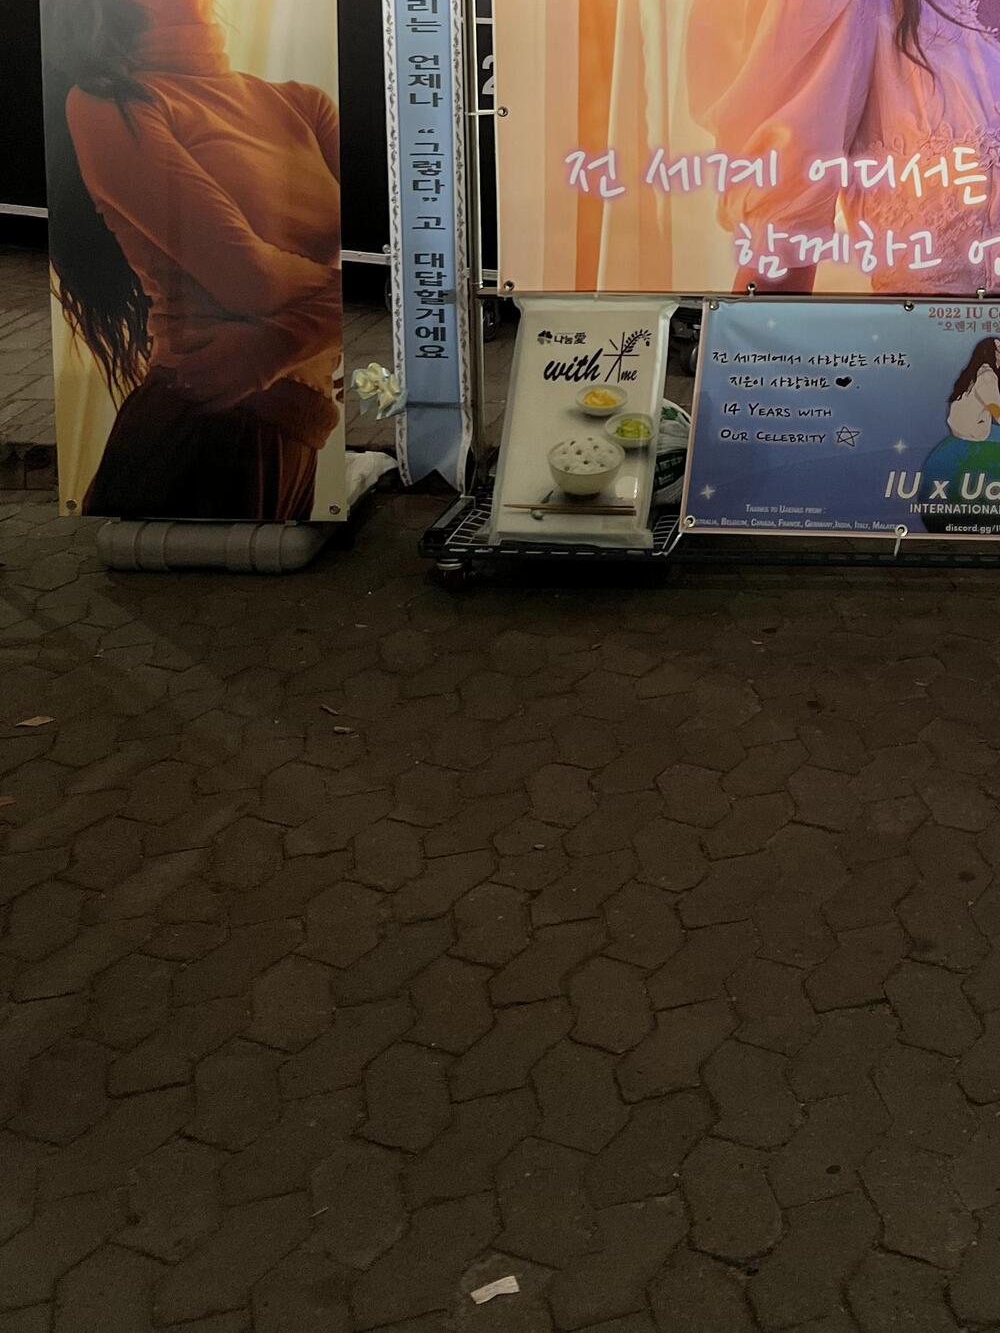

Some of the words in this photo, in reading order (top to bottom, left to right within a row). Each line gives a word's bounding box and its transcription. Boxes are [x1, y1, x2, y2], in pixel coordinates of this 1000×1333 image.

[408, 54, 444, 108] 언제나
[565, 149, 626, 198] 전
[646, 148, 777, 192] 세계
[808, 147, 988, 205] 어디서든
[734, 222, 941, 278] 함께하고
[928, 307, 961, 319] 2022
[966, 307, 983, 319] IU
[543, 348, 603, 382] with
[620, 368, 637, 381] me
[712, 351, 728, 364] 전
[733, 351, 801, 364] 세계에서
[807, 353, 868, 367] 사랑받는
[729, 375, 764, 388] 지은이
[770, 375, 830, 389] 사랑해요
[723, 402, 740, 415] 14
[884, 470, 922, 499] IU
[928, 479, 950, 499] x
